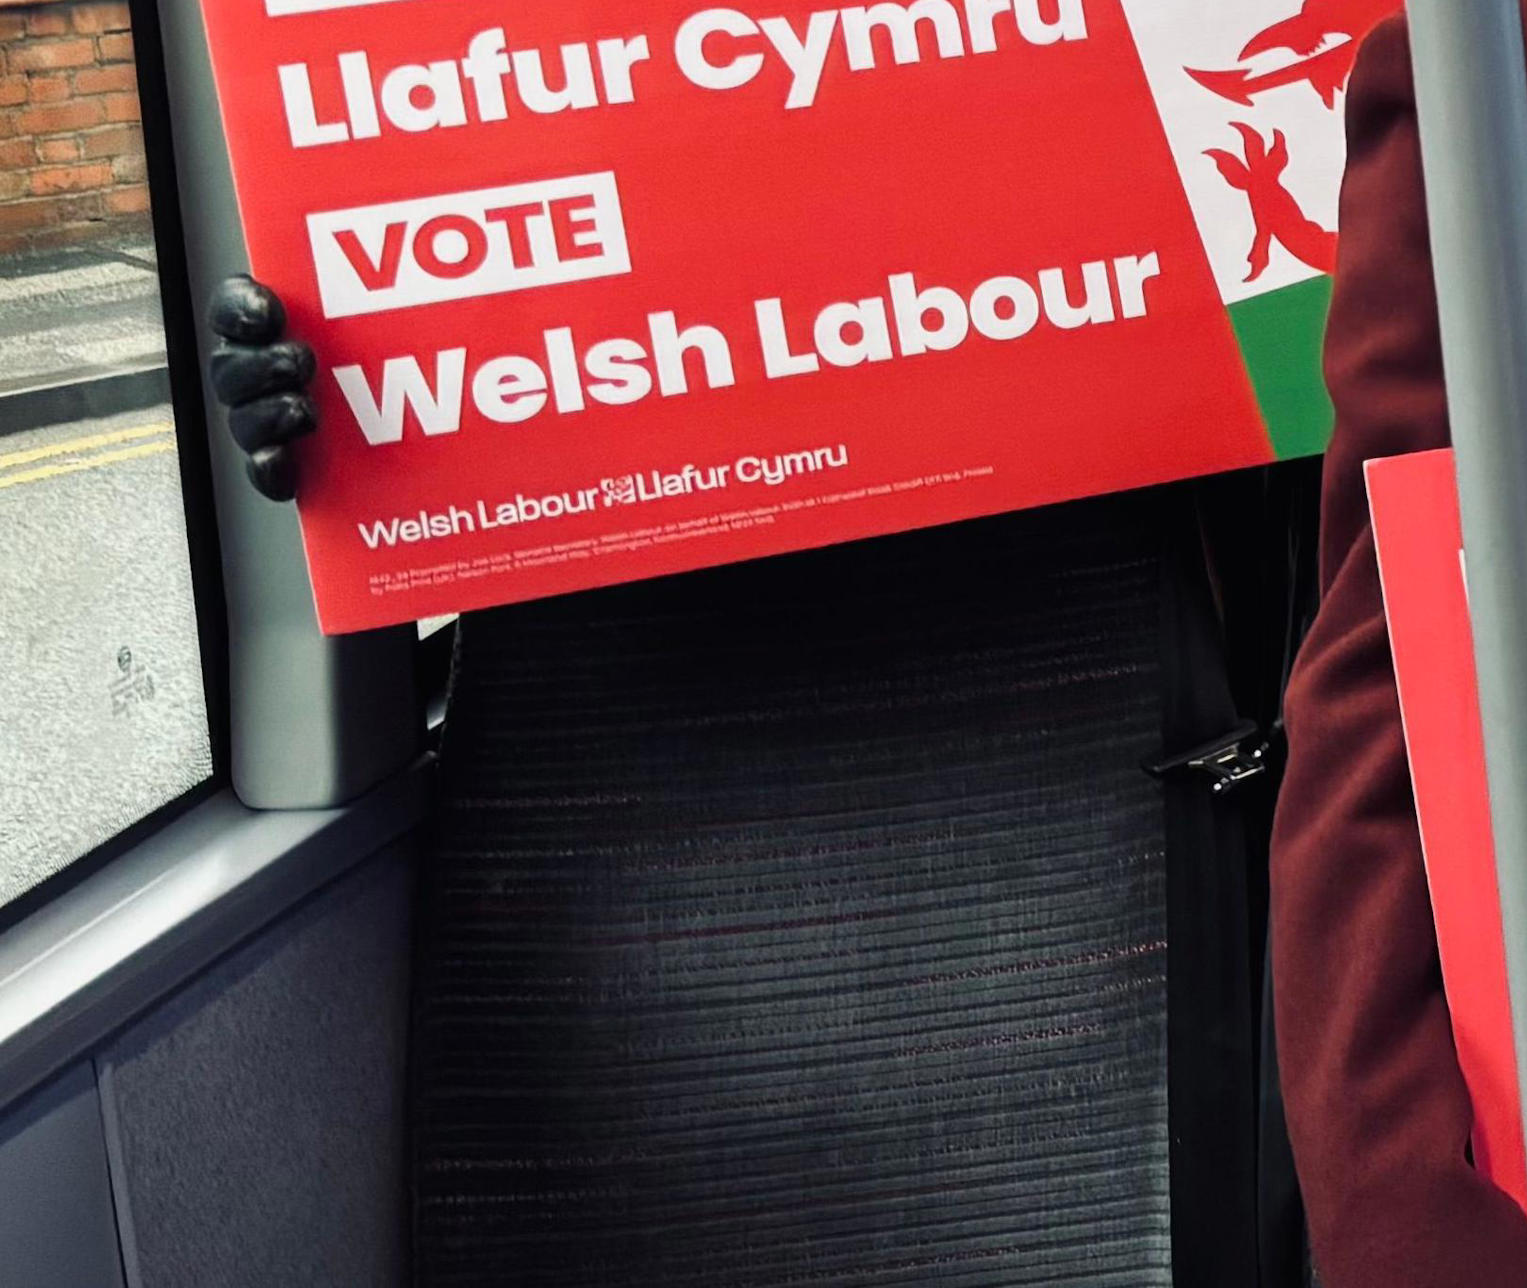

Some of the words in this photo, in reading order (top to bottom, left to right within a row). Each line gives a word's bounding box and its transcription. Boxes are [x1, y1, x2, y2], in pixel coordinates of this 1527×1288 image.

[278, 28, 649, 147] Llafur
[337, 195, 602, 289] VOTE
[333, 311, 734, 444] Welsh
[756, 252, 1160, 378] Labour
[359, 506, 474, 548] Welsh
[478, 488, 598, 528] Labour
[636, 465, 729, 501] Llafur
[736, 445, 847, 484] Cymru
